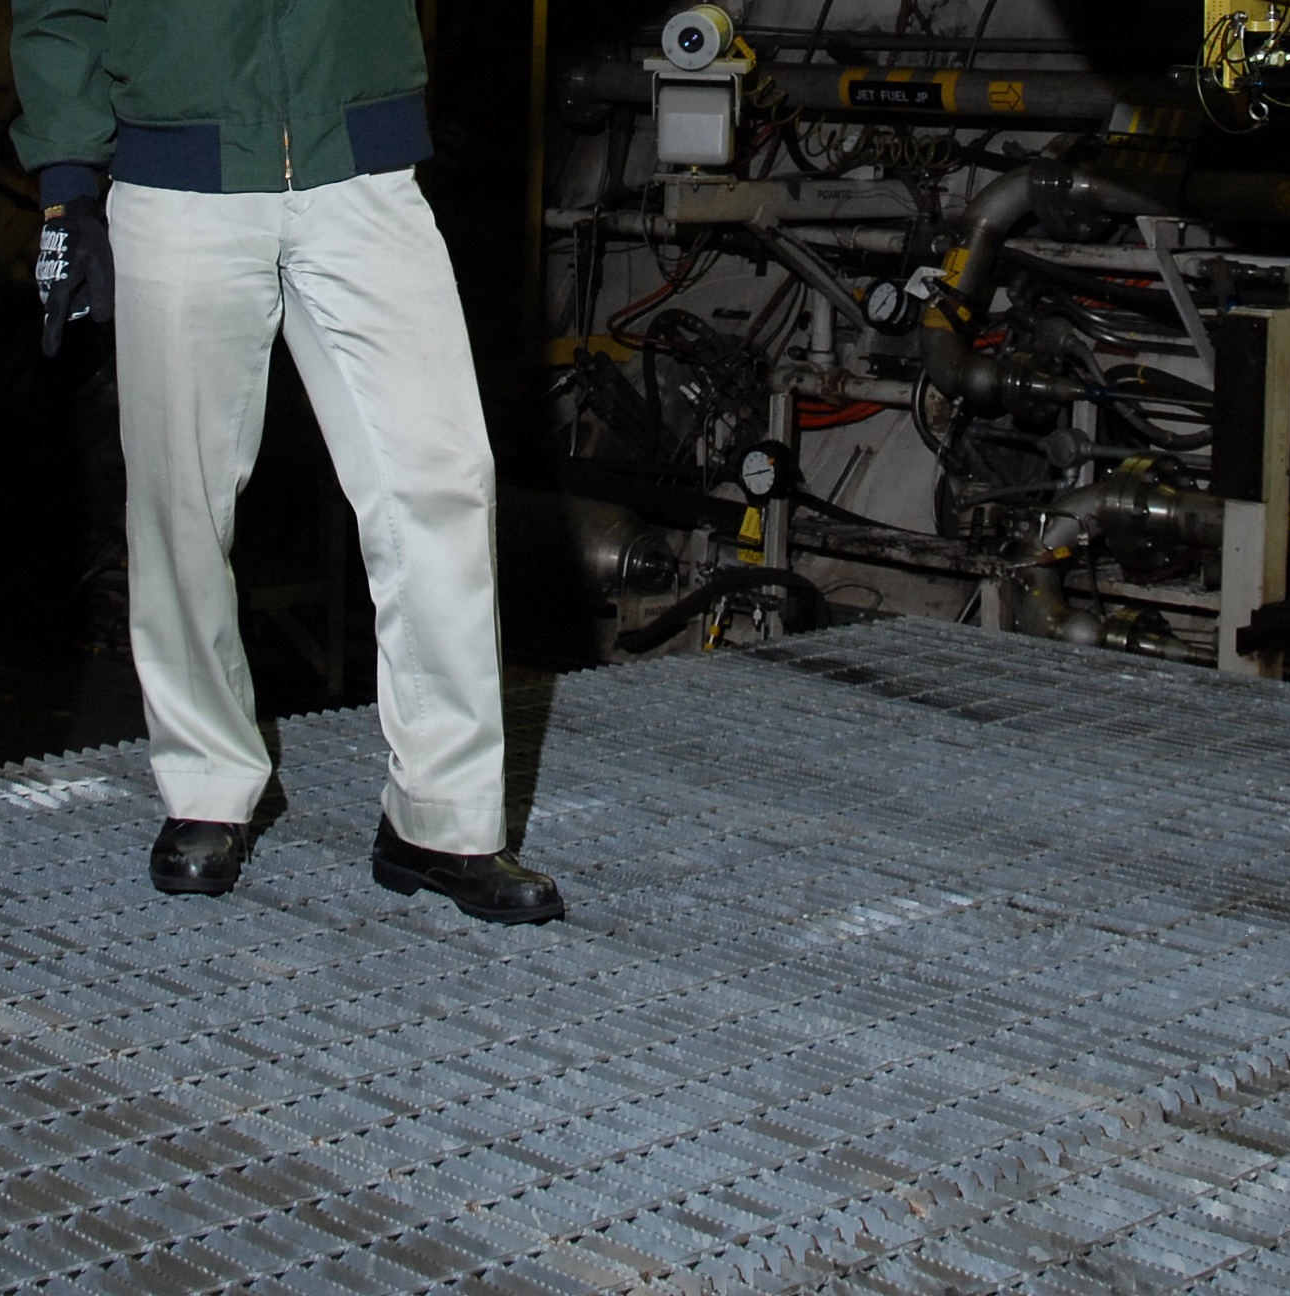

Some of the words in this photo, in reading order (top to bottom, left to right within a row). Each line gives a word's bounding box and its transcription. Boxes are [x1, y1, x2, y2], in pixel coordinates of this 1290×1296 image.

[855, 89, 875, 101] JET
[881, 90, 909, 102] FUEL
[914, 92, 929, 104] JP
